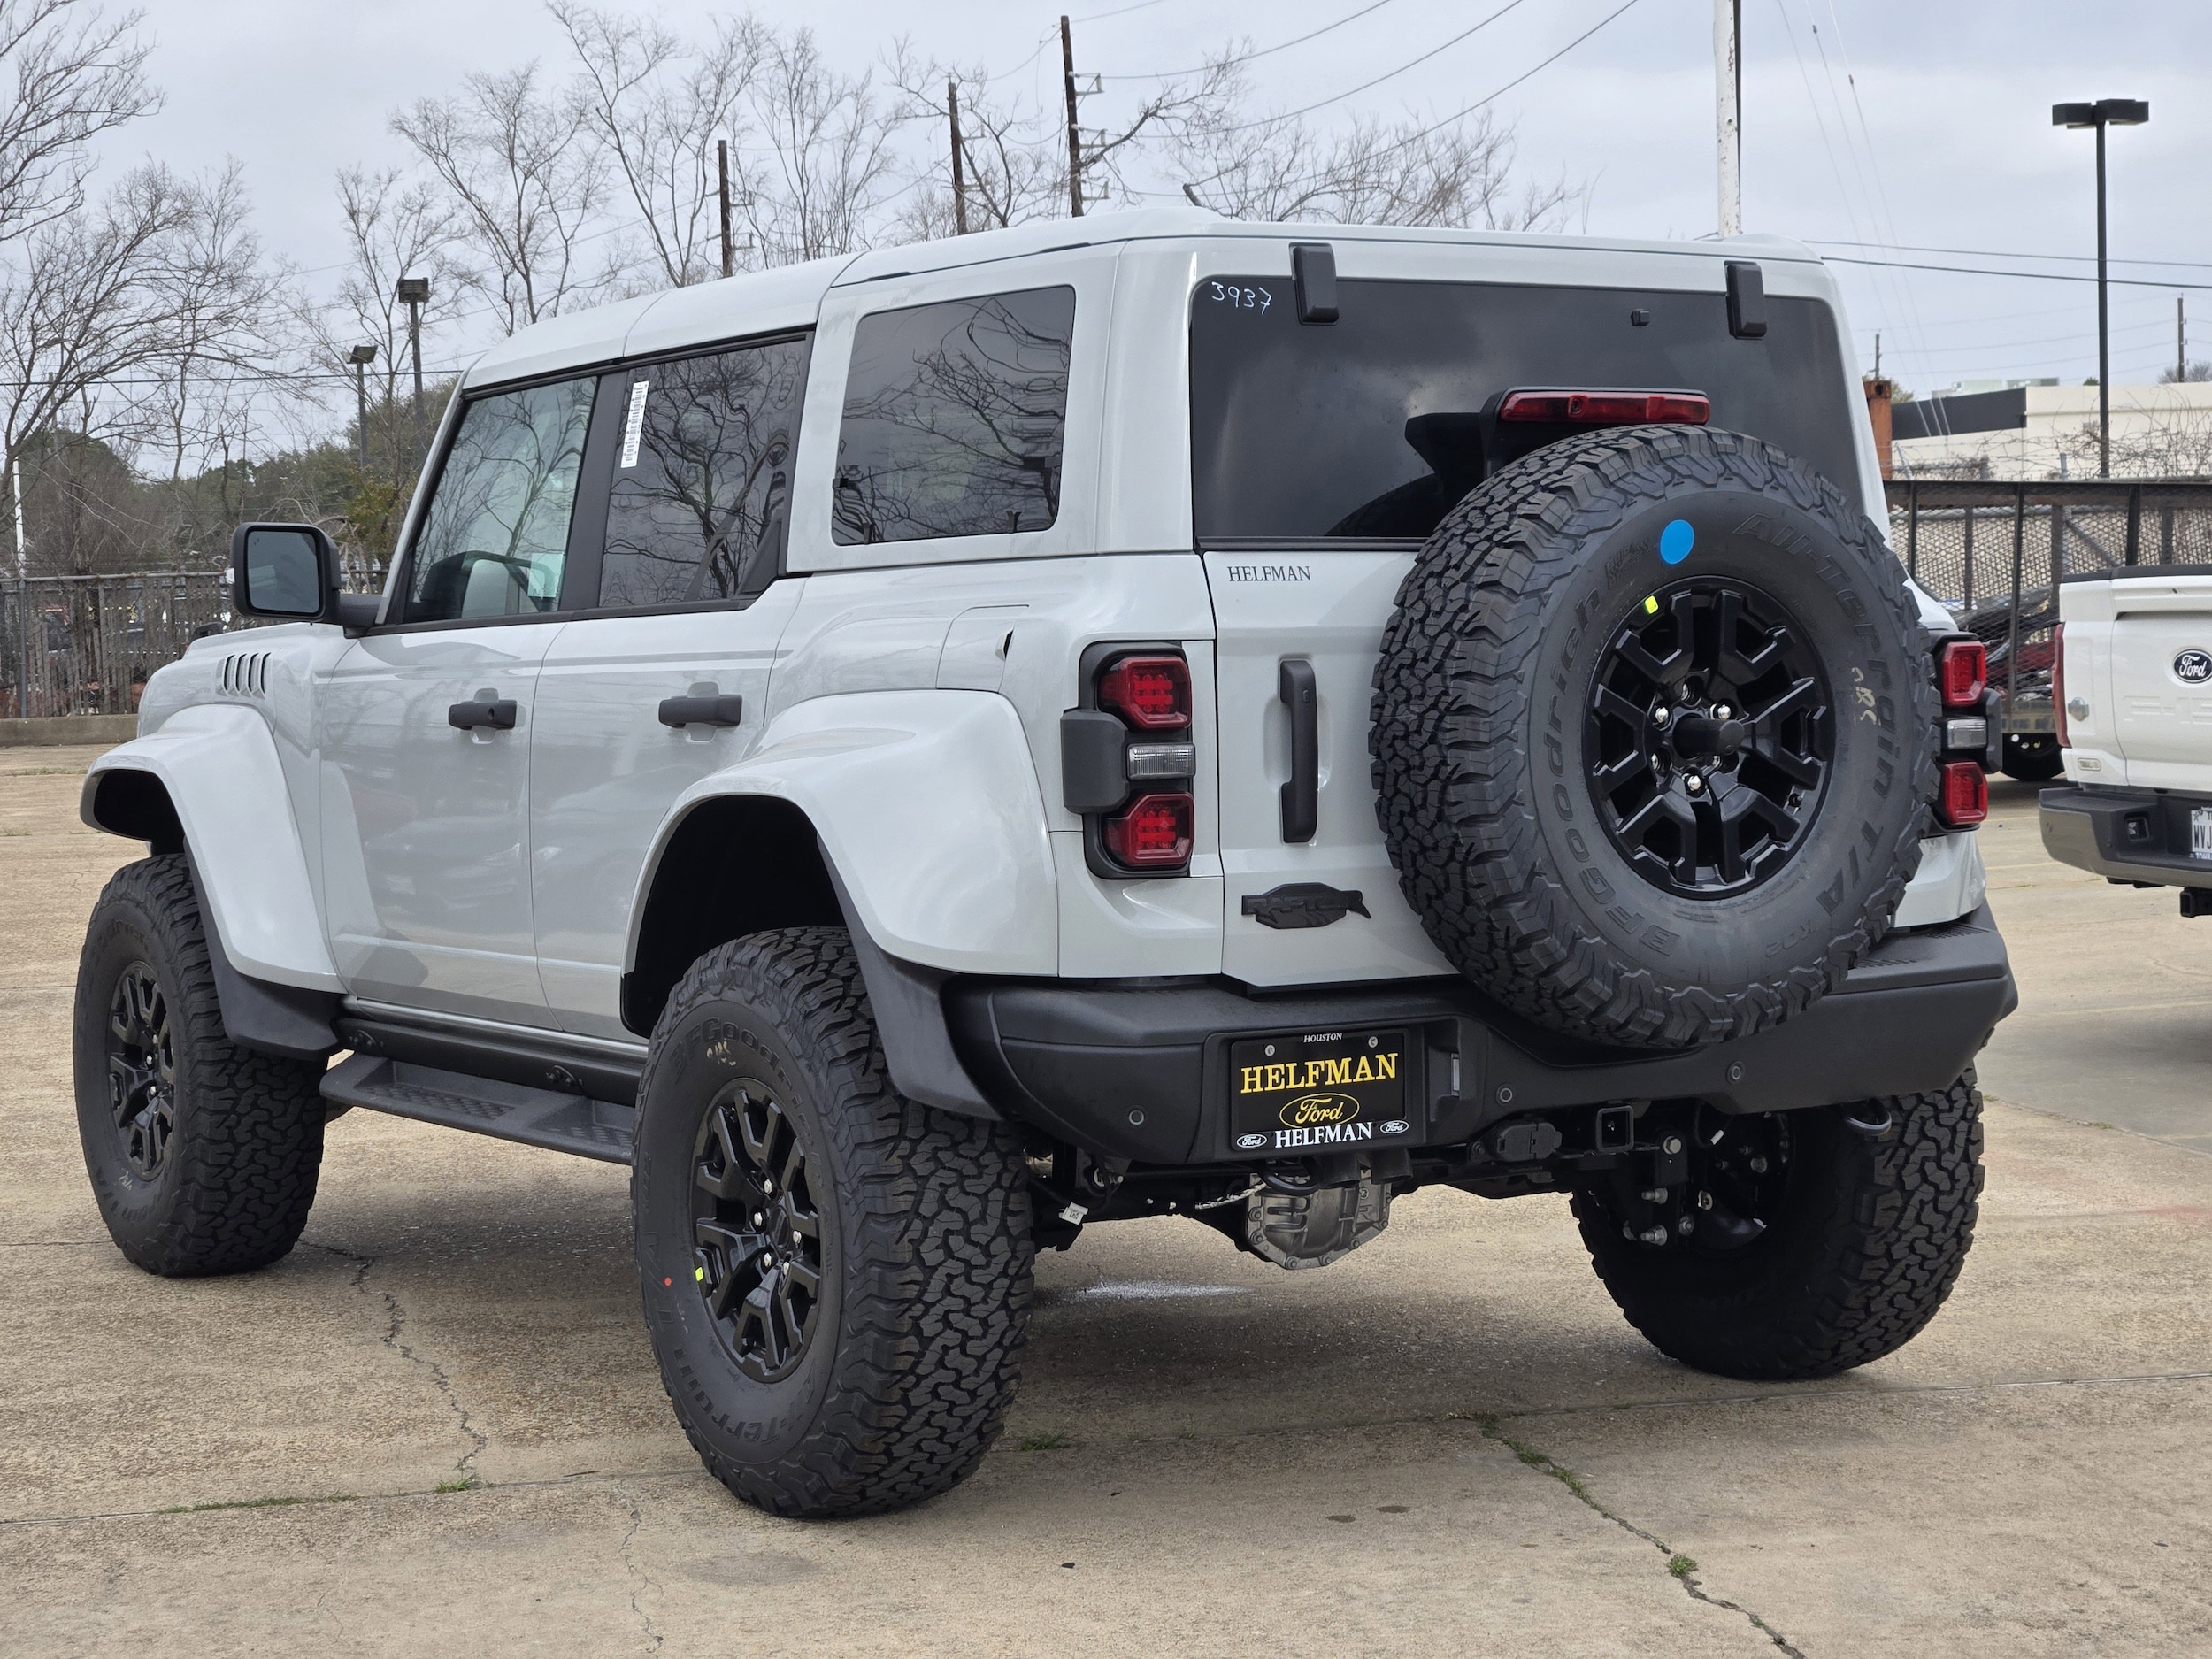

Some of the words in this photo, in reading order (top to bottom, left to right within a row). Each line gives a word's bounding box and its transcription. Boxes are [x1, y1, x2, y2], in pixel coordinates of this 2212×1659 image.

[1211, 281, 1272, 315] 3937
[1226, 565, 1311, 582] HELFMAN
[2178, 654, 2208, 678] Ford
[1302, 1032, 1343, 1043] HOUSTON
[1240, 1052, 1399, 1094] HELFMAN
[1294, 1097, 1344, 1125] Ford
[1274, 1122, 1373, 1148] HELFMAN
